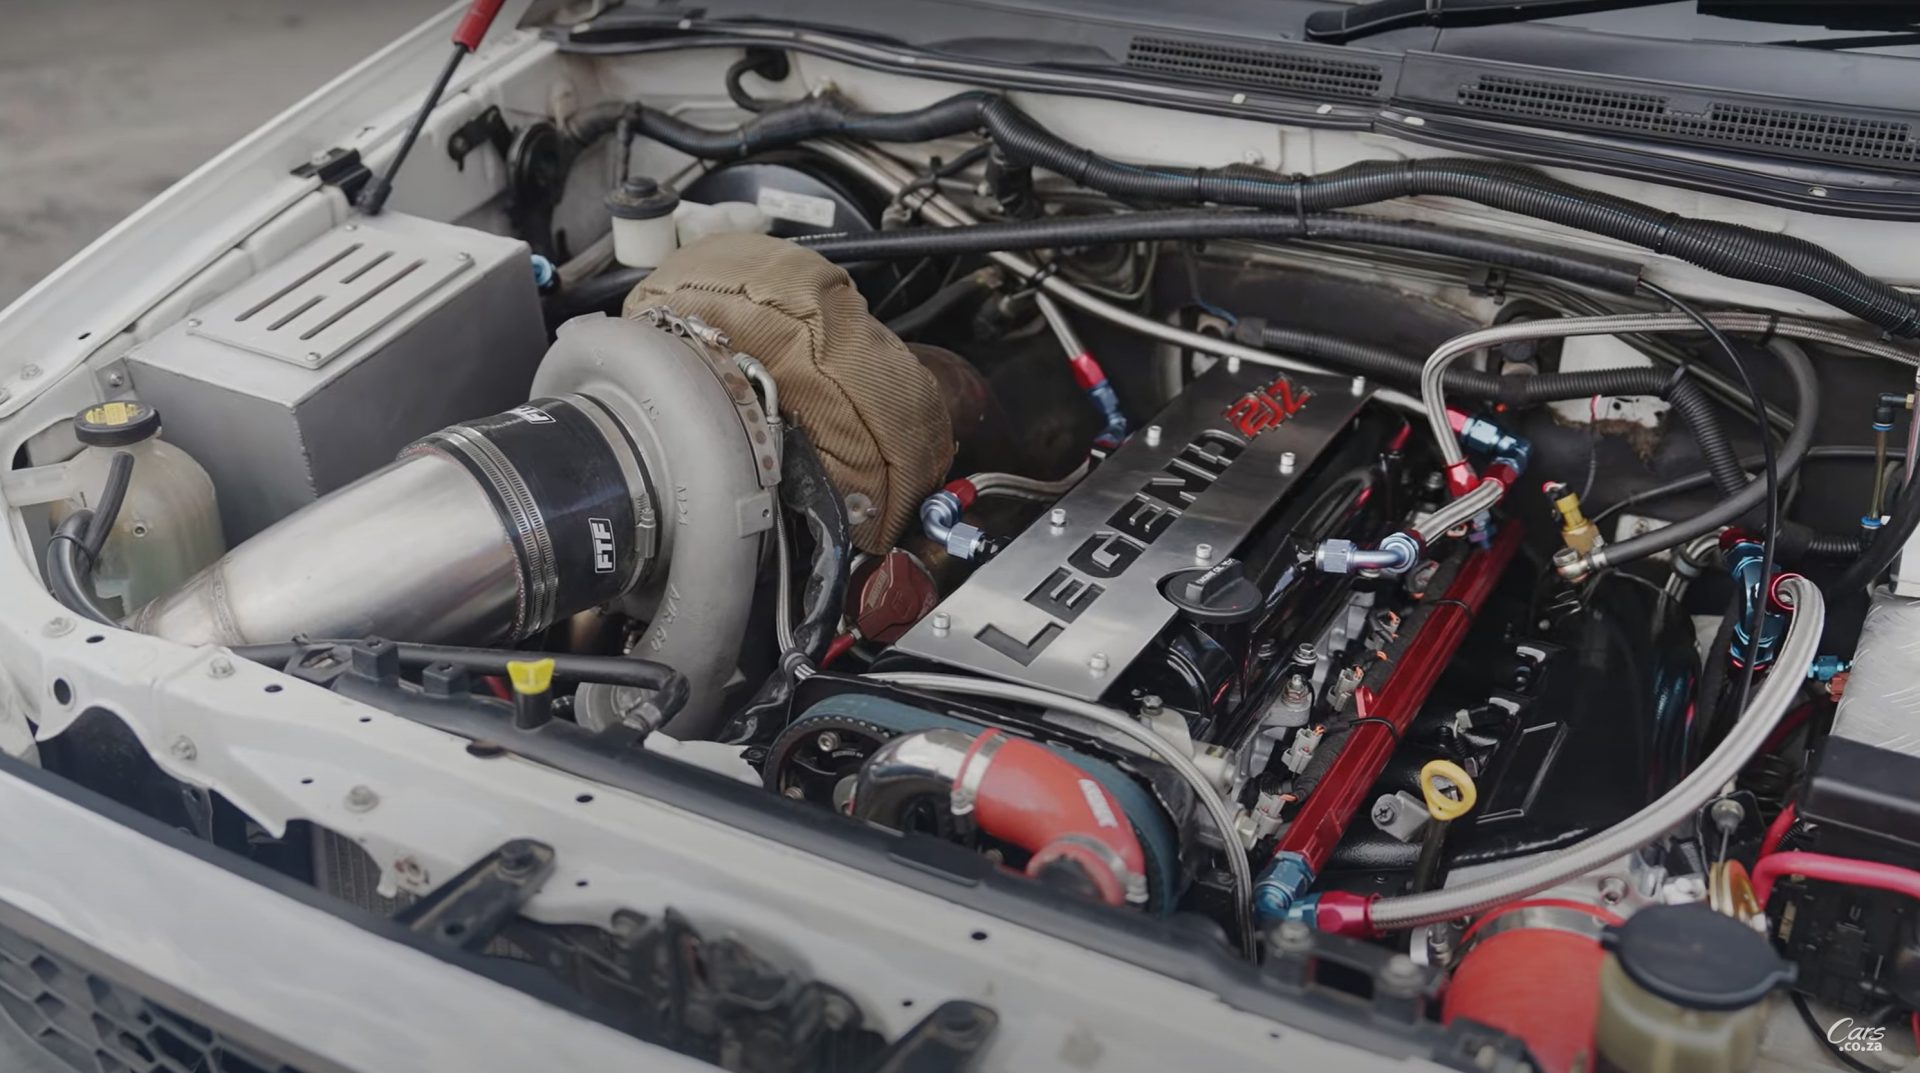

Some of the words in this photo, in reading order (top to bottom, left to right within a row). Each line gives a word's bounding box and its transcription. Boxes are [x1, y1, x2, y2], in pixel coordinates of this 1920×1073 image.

[591, 522, 613, 569] FTF
[974, 428, 1247, 667] LEGEND
[1223, 373, 1314, 440] 2JZ
